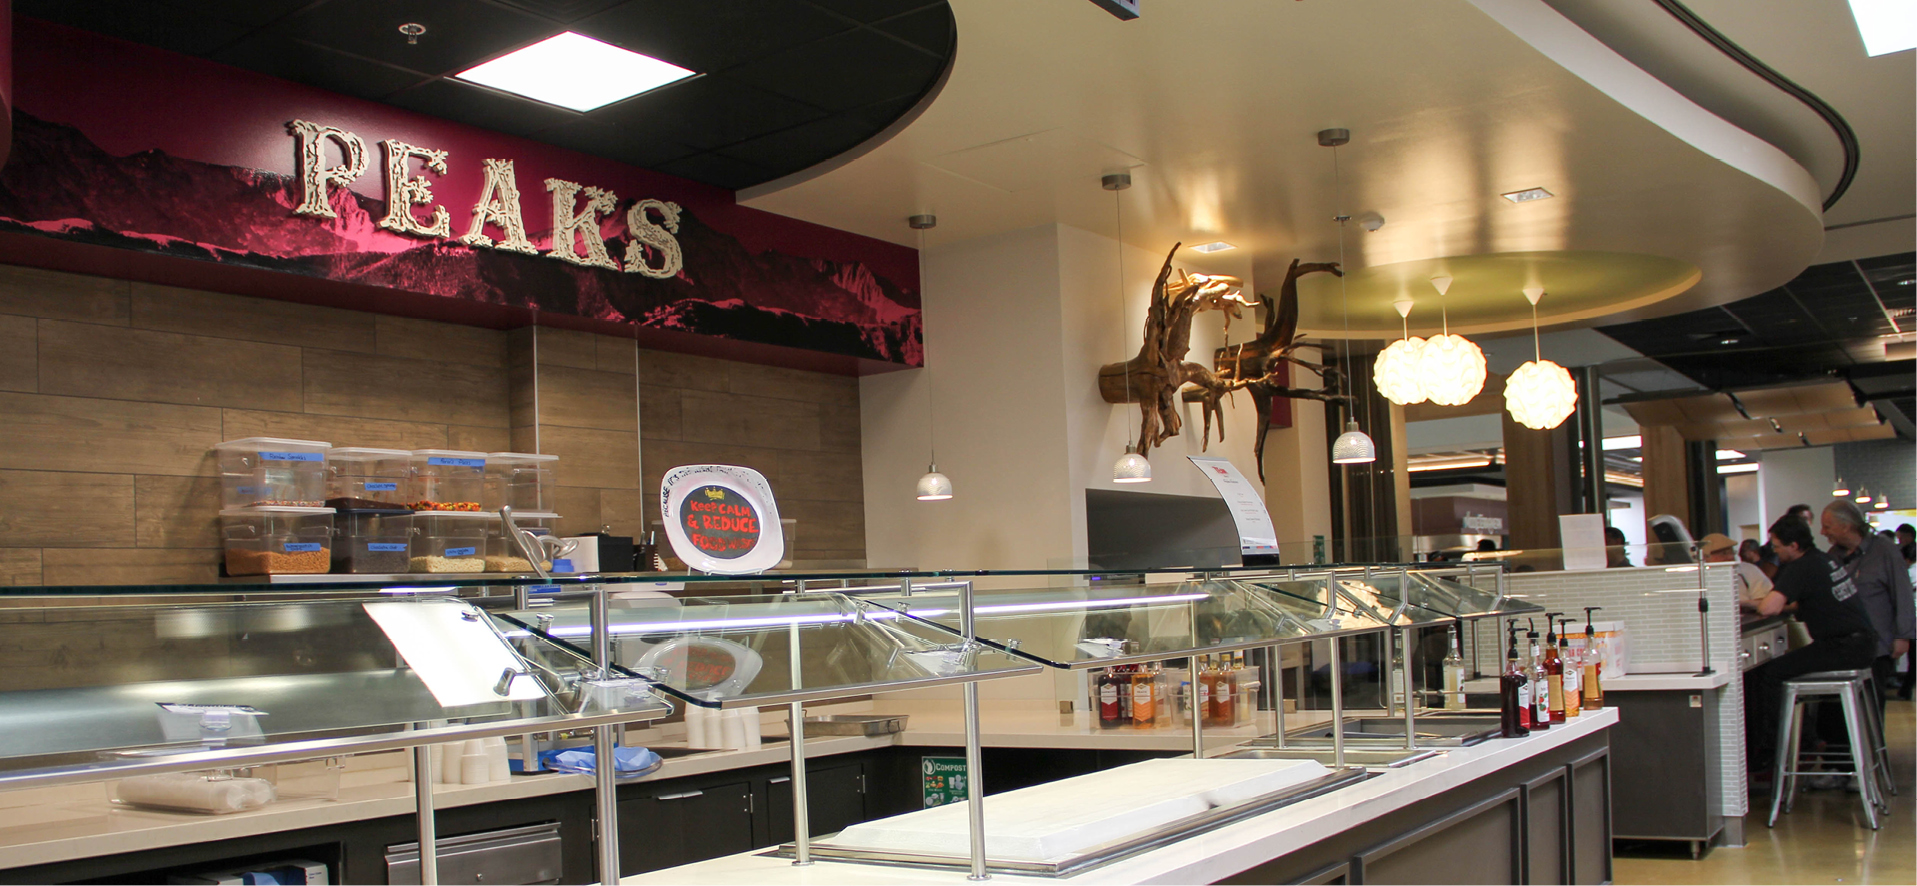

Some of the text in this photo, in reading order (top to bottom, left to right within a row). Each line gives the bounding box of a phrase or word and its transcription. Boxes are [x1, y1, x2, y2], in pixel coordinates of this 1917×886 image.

[290, 118, 683, 280] PEAKS
[718, 503, 751, 517] CALM
[687, 513, 759, 533] & REDUCE
[691, 533, 727, 552] FOOD
